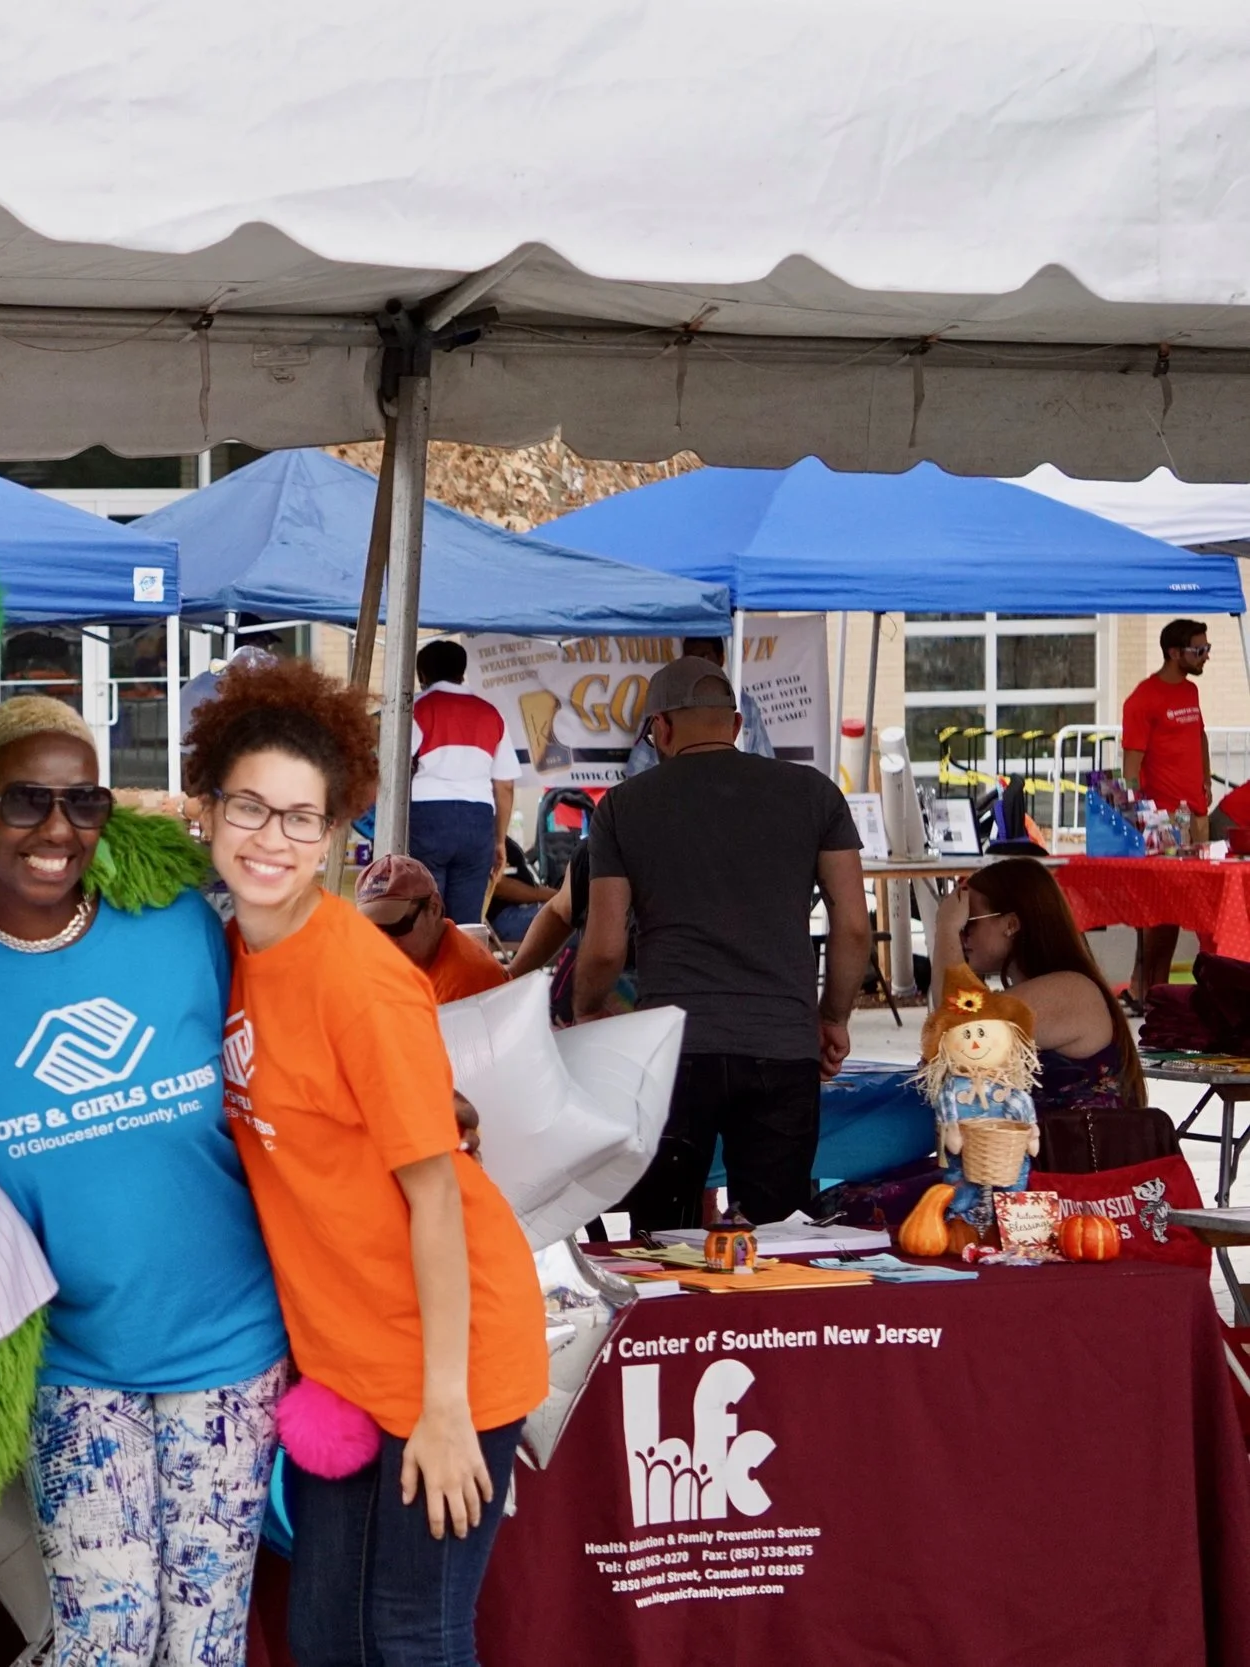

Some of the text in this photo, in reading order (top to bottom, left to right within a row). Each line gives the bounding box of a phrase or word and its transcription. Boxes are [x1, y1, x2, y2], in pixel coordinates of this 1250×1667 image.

[775, 674, 800, 687] PAID
[570, 673, 650, 734] GO
[771, 700, 794, 713] HOW
[46, 1108, 69, 1128] &
[72, 1086, 147, 1121] GIRLS
[151, 1065, 216, 1100] CLUBS
[28, 1120, 115, 1154] Gloucester
[116, 1106, 177, 1131] County,
[179, 1099, 203, 1116] Inc.
[618, 1335, 689, 1358] Center
[694, 1330, 717, 1353] of
[721, 1327, 817, 1350] Southern
[823, 1325, 870, 1345] New
[875, 1323, 942, 1348] Jersey
[585, 1542, 627, 1555] Health
[667, 1533, 676, 1545] &
[677, 1530, 714, 1545] Family
[716, 1528, 775, 1542] Prevention
[777, 1525, 821, 1538] Services
[702, 1545, 814, 1562] Fax: (856) 338-0875
[597, 1560, 623, 1573] Tel:
[612, 1579, 641, 1592] 2850
[667, 1570, 702, 1583] Street,
[704, 1566, 749, 1580] Camden
[751, 1565, 766, 1577] NJ
[768, 1564, 805, 1576] 08105
